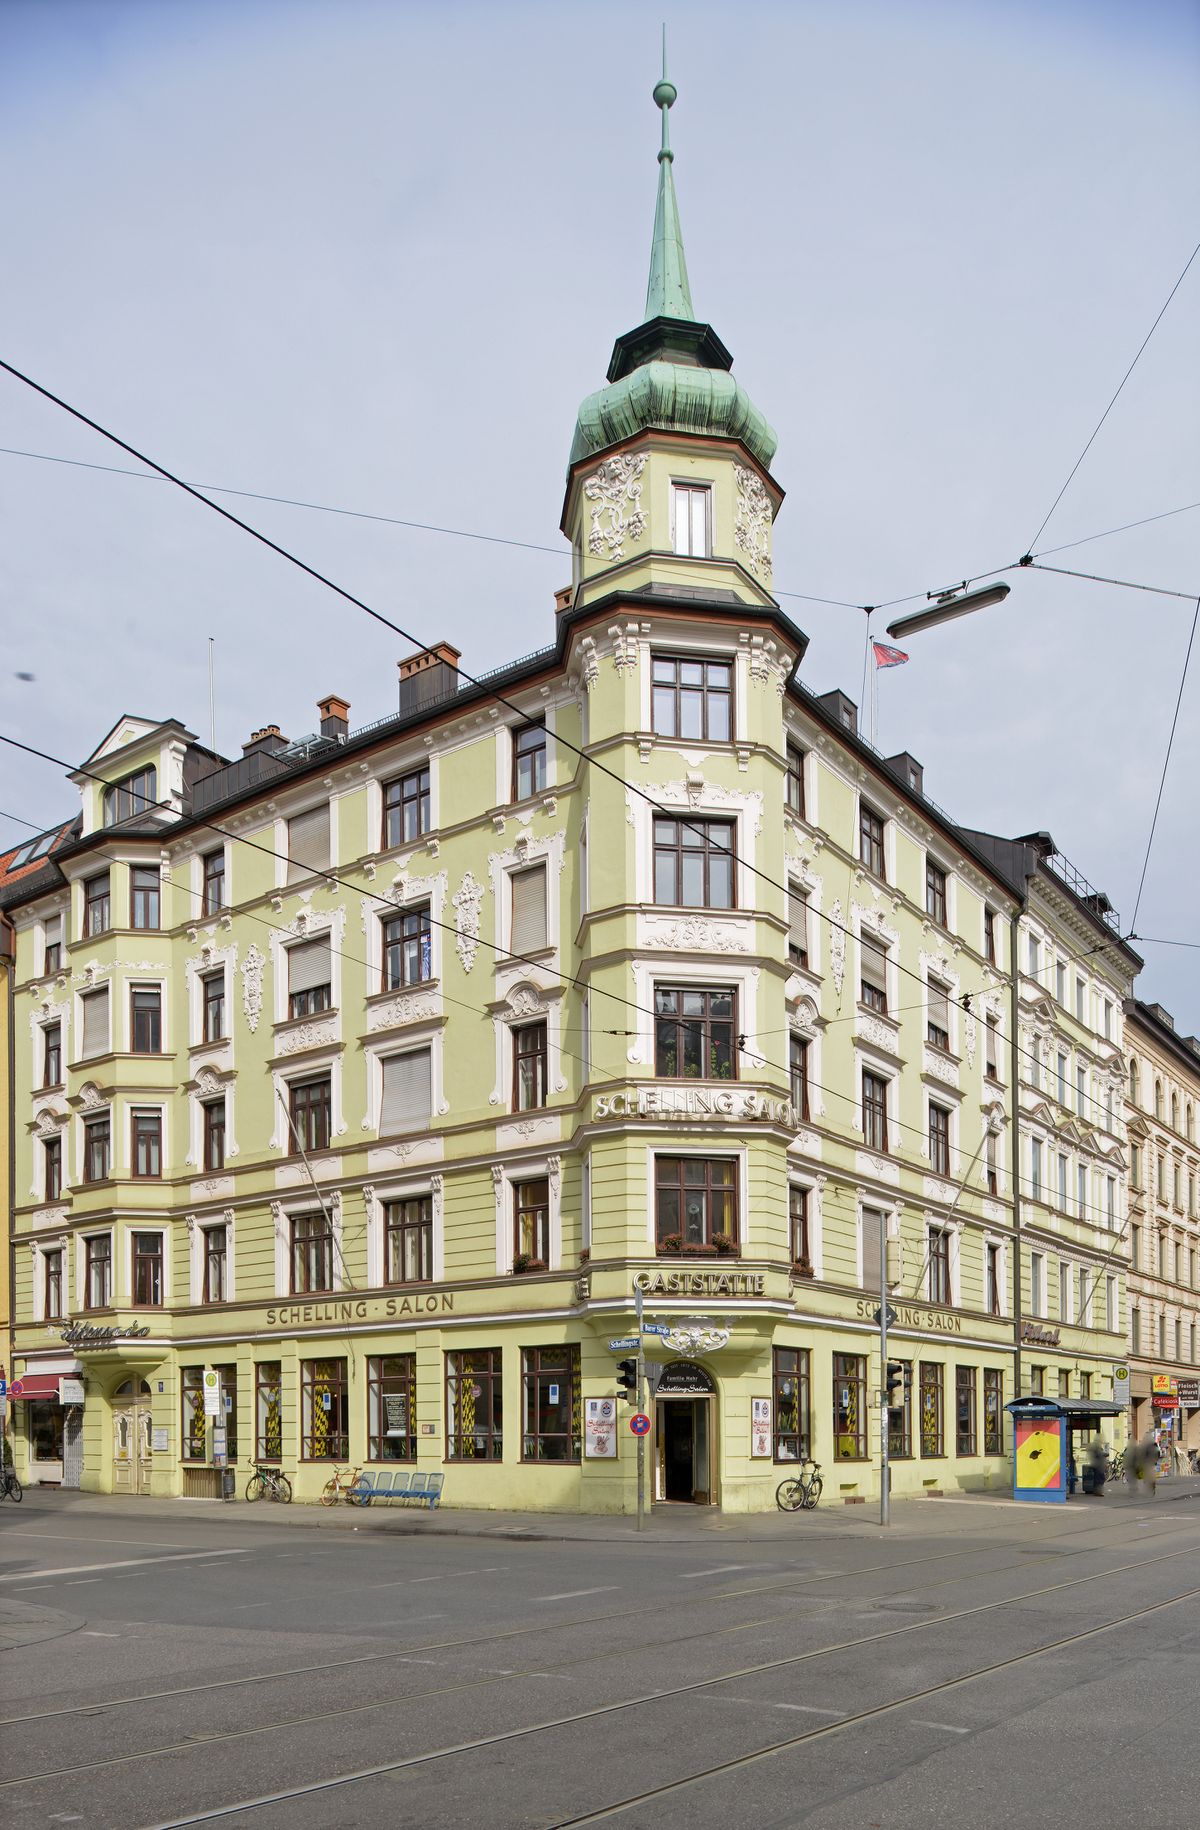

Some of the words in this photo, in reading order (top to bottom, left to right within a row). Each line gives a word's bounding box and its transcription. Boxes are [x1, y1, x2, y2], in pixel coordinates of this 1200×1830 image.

[596, 1090, 734, 1118] SCHELLING
[742, 1095, 798, 1130] SALON
[266, 1301, 367, 1325] SCHELLING
[386, 1294, 454, 1316] SALON
[856, 1301, 920, 1326] SCHLING
[927, 1313, 961, 1332] SALON
